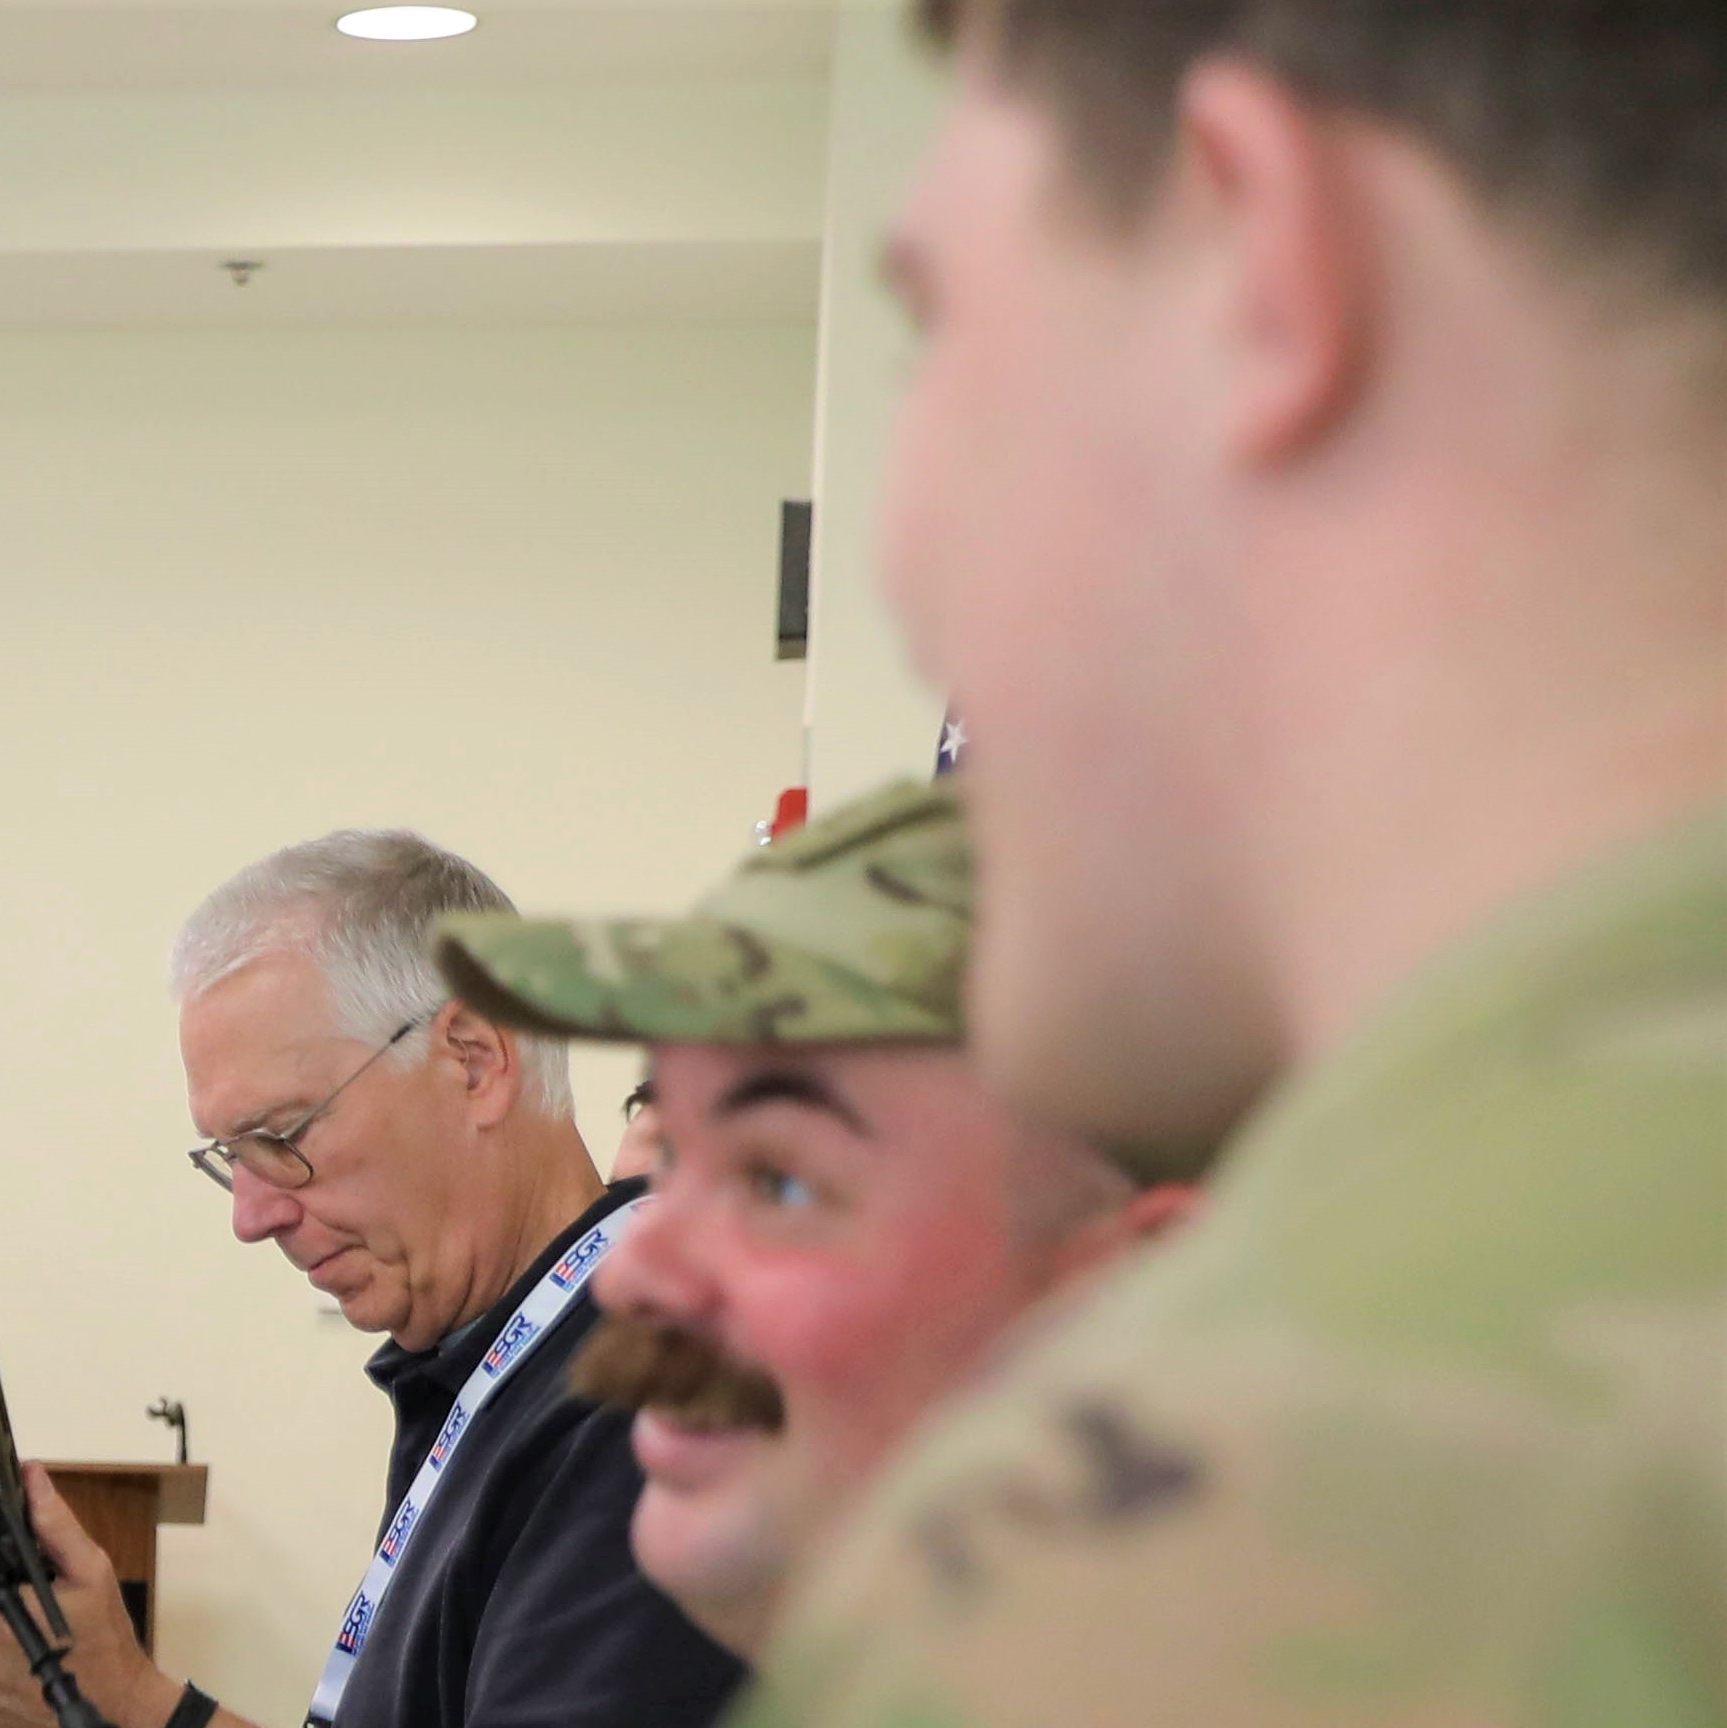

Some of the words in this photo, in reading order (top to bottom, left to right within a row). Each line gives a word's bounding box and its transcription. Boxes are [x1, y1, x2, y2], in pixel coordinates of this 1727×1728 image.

[549, 1228, 609, 1288] ESGR
[481, 1311, 533, 1377] ESGR
[429, 1402, 467, 1469] ESGR
[379, 1496, 415, 1563] ESGR
[335, 1590, 371, 1657] ESGR
